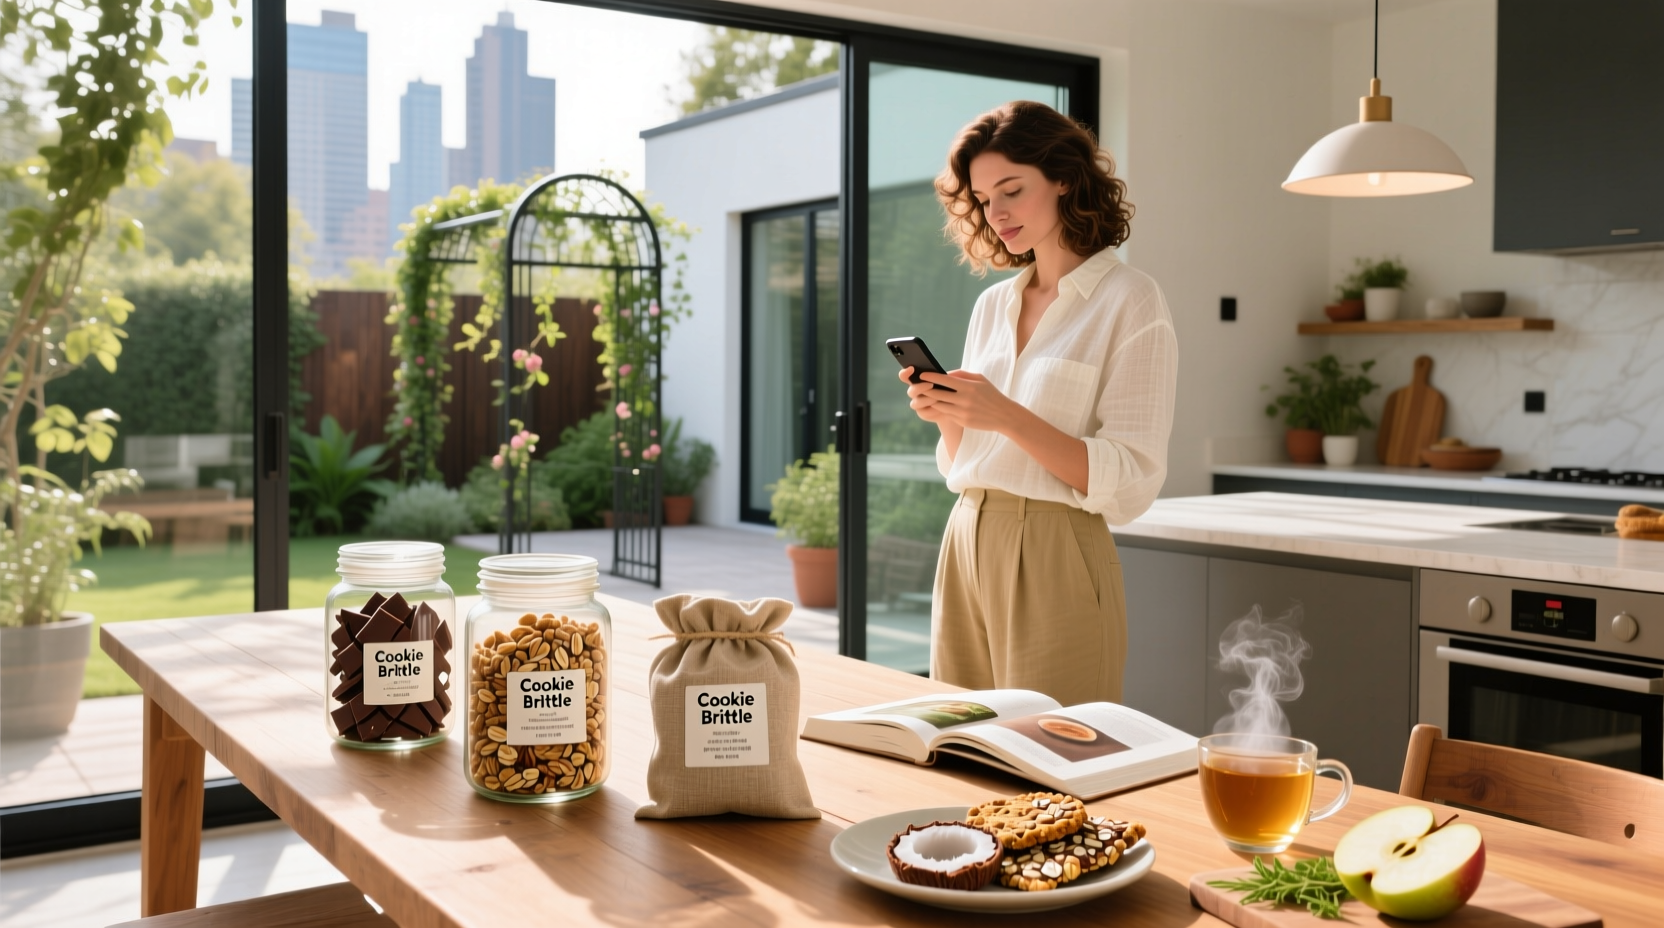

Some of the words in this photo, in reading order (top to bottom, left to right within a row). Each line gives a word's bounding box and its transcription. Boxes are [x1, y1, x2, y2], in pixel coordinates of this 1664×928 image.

[375, 648, 423, 662] Cookie
[520, 676, 574, 692] Cookie
[698, 691, 754, 707] Cookie
[702, 709, 752, 725] Brittle
